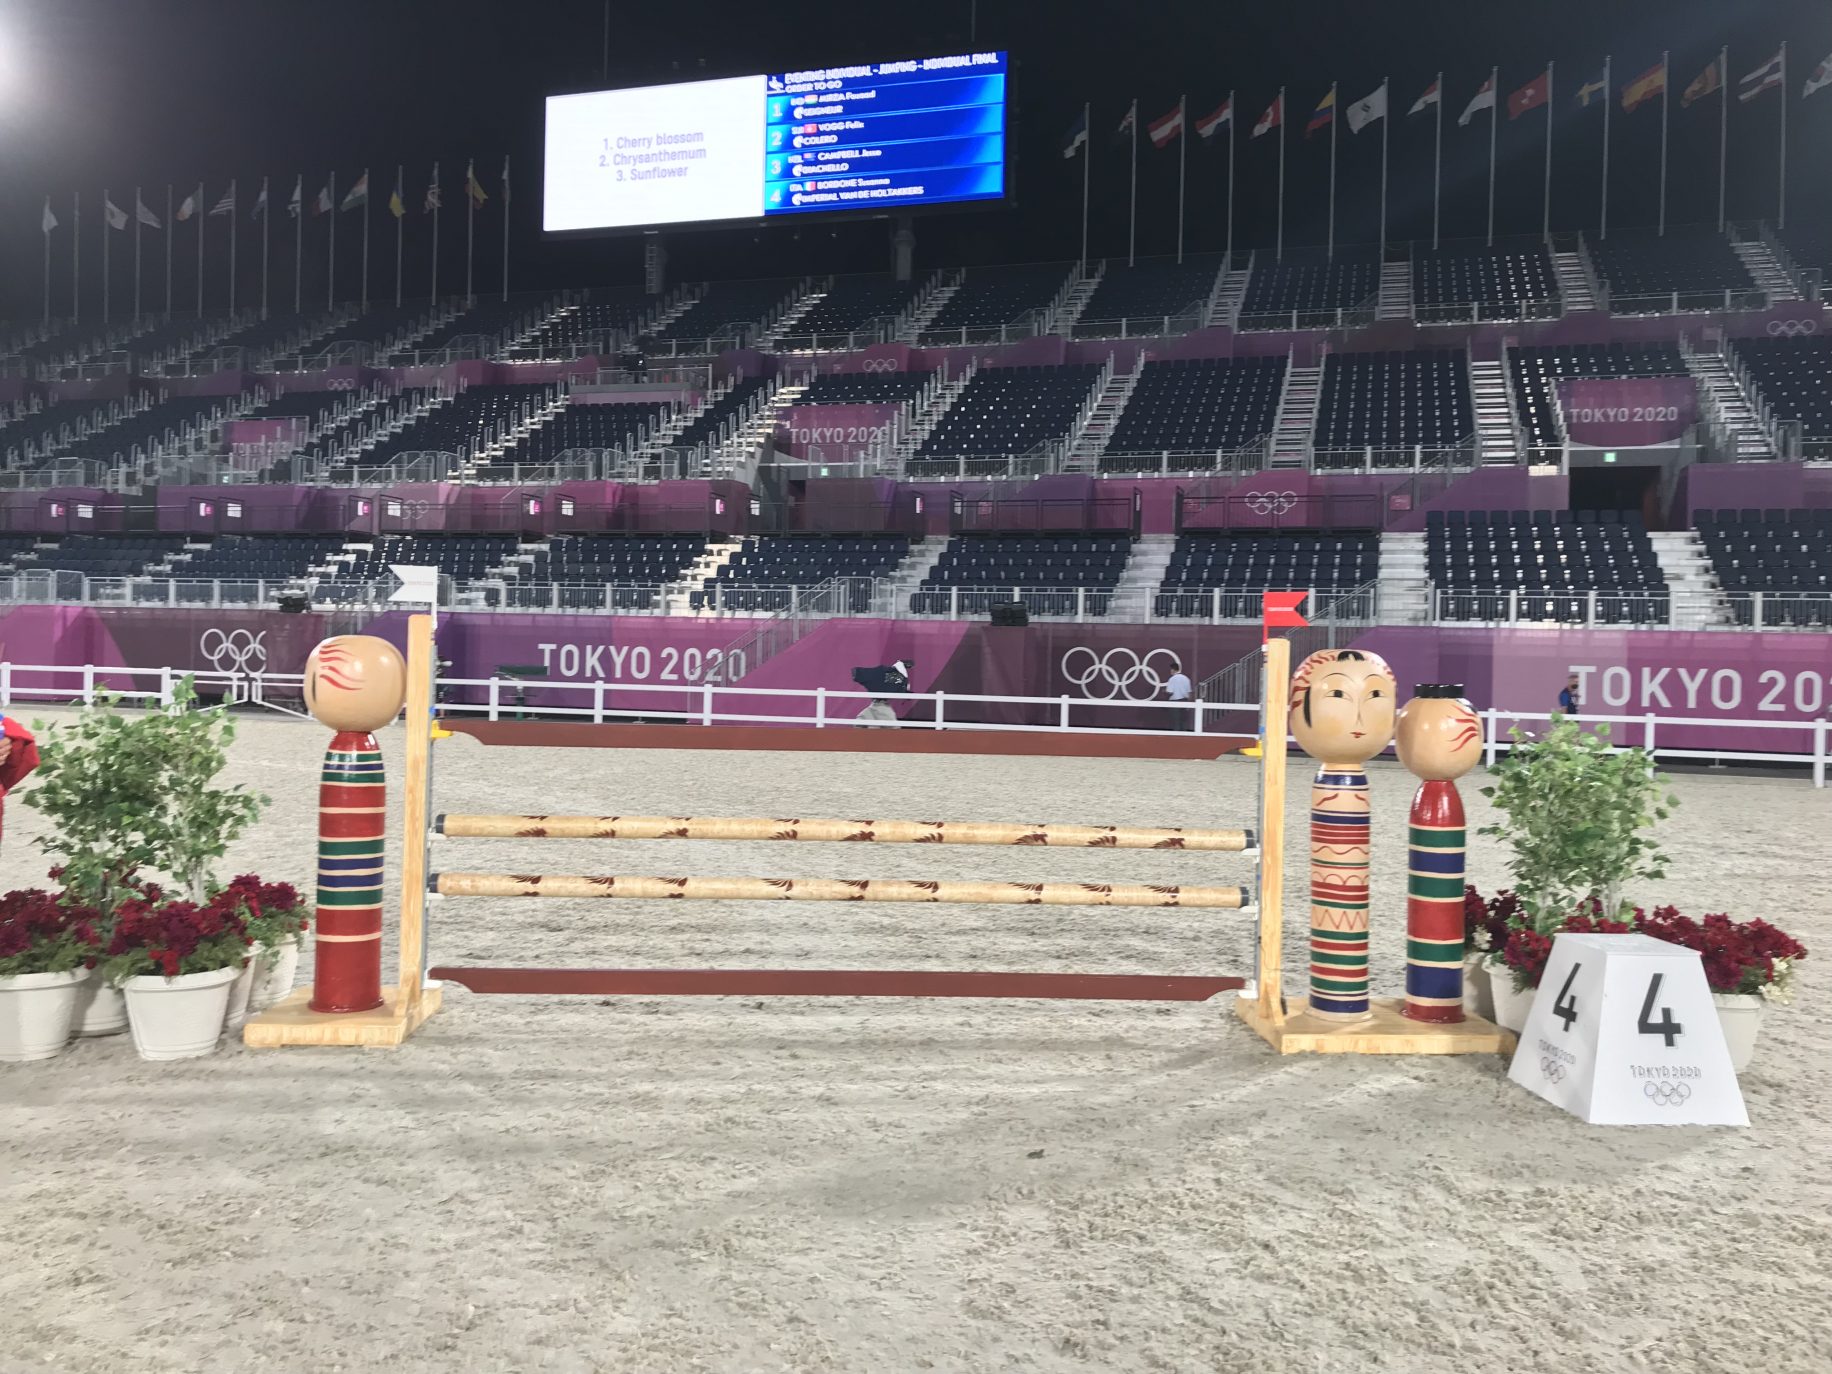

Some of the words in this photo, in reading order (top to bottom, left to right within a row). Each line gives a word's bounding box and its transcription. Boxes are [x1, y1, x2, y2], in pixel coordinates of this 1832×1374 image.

[772, 102, 783, 117] 1
[603, 138, 614, 151] 1.
[616, 136, 653, 150] Cherry
[656, 132, 704, 146] blossom
[771, 130, 783, 146] 2
[599, 154, 610, 168] 2.
[613, 149, 707, 167] Chrysanthemum
[616, 169, 628, 182] 3.
[630, 166, 688, 181] Sunflower
[771, 160, 782, 175] 3
[770, 188, 782, 203] 4
[1569, 407, 1630, 423] TOKYO
[1632, 406, 1679, 422] 2020
[790, 427, 844, 444] TOKYO
[537, 643, 651, 680] TOKYO
[660, 647, 747, 683] 2020
[1568, 665, 1743, 710] TOKYO
[1757, 669, 1832, 713] 20
[1552, 962, 1582, 1032] 4
[1637, 972, 1684, 1048] 4
